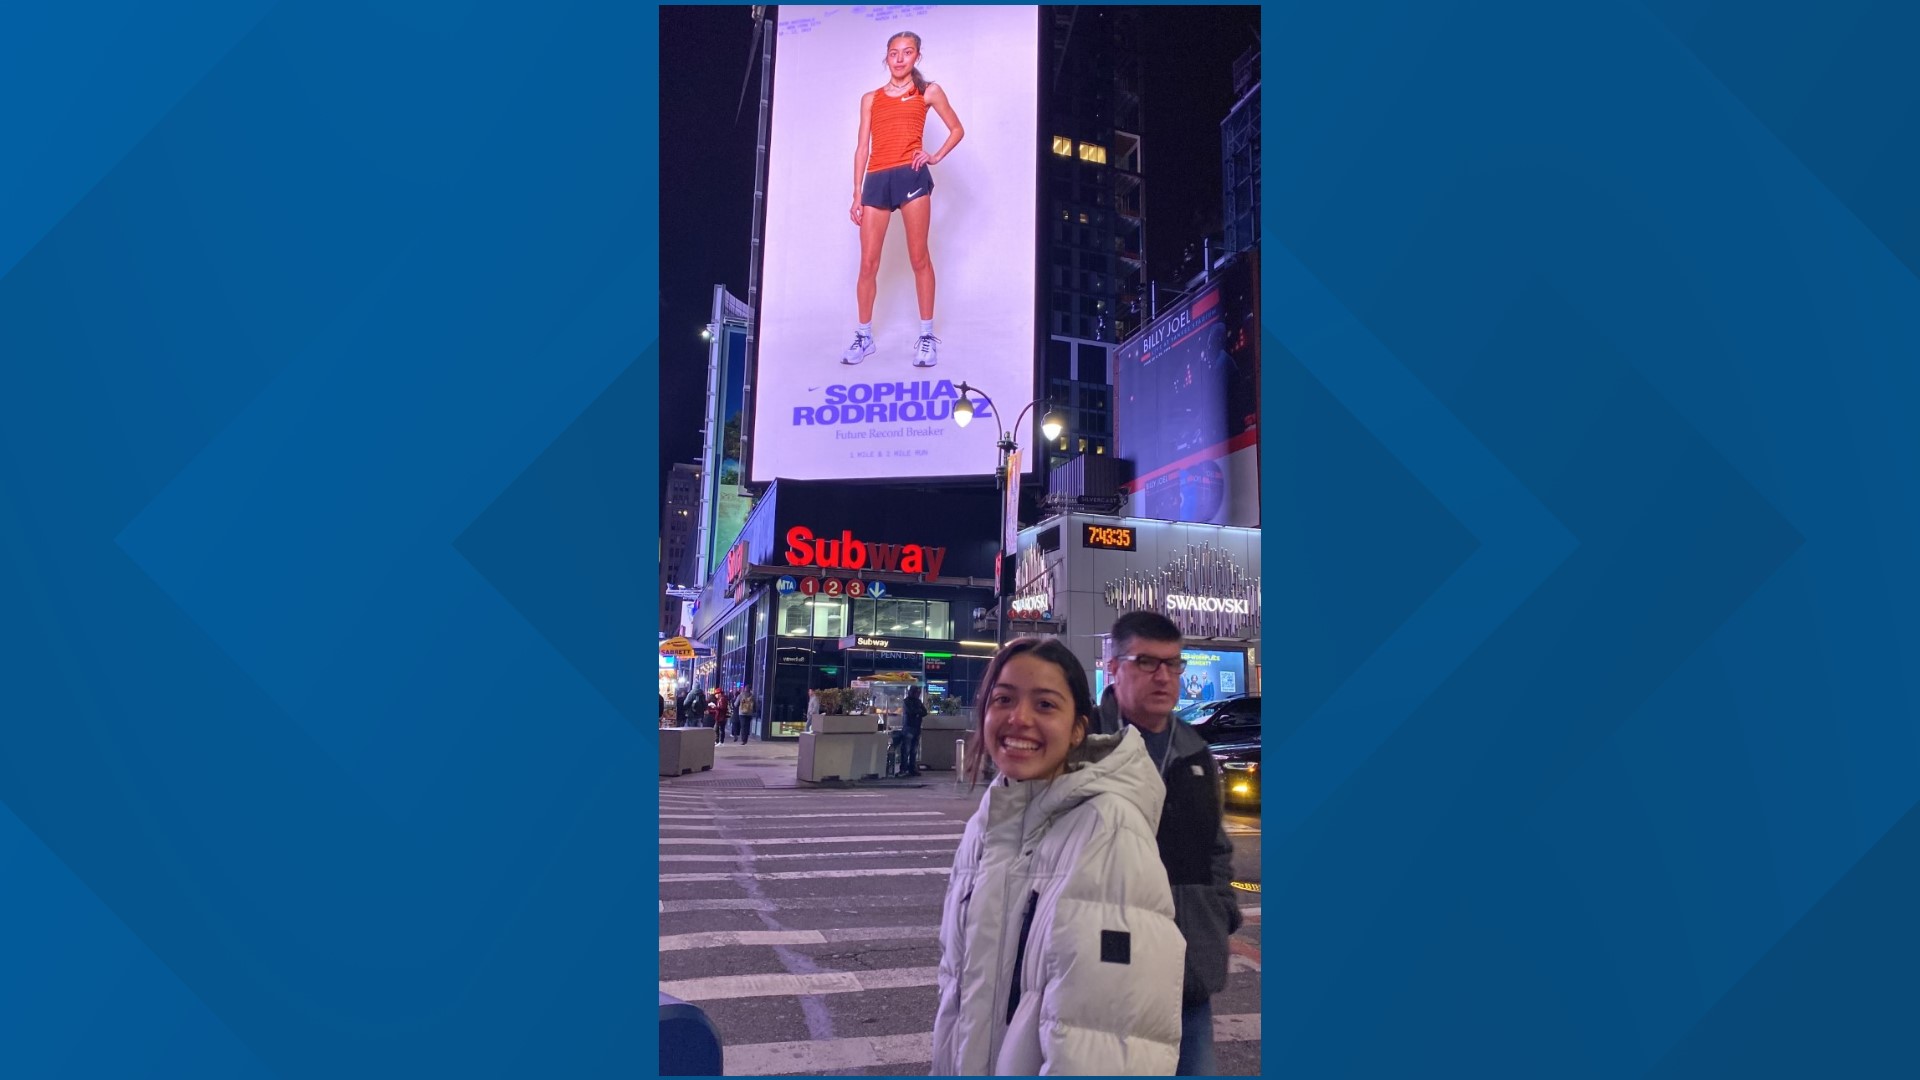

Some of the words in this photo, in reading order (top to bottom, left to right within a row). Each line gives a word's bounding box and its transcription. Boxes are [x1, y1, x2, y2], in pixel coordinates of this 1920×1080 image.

[1143, 326, 1165, 354] BILLY
[1166, 309, 1191, 337] JOEL
[825, 379, 958, 405] SOPHIA
[793, 398, 993, 426] RODRIQUZ
[835, 429, 867, 440] Future
[869, 426, 904, 438] Record
[906, 426, 944, 438] Breaker
[1088, 526, 1130, 546] 7:43:35
[785, 525, 946, 583] Subway
[780, 579, 794, 591] MTA
[828, 581, 839, 594] 2
[850, 582, 861, 595] 3
[1166, 594, 1249, 614] SWAROVSKI
[857, 637, 889, 648] Subway
[881, 651, 902, 659] PENN
